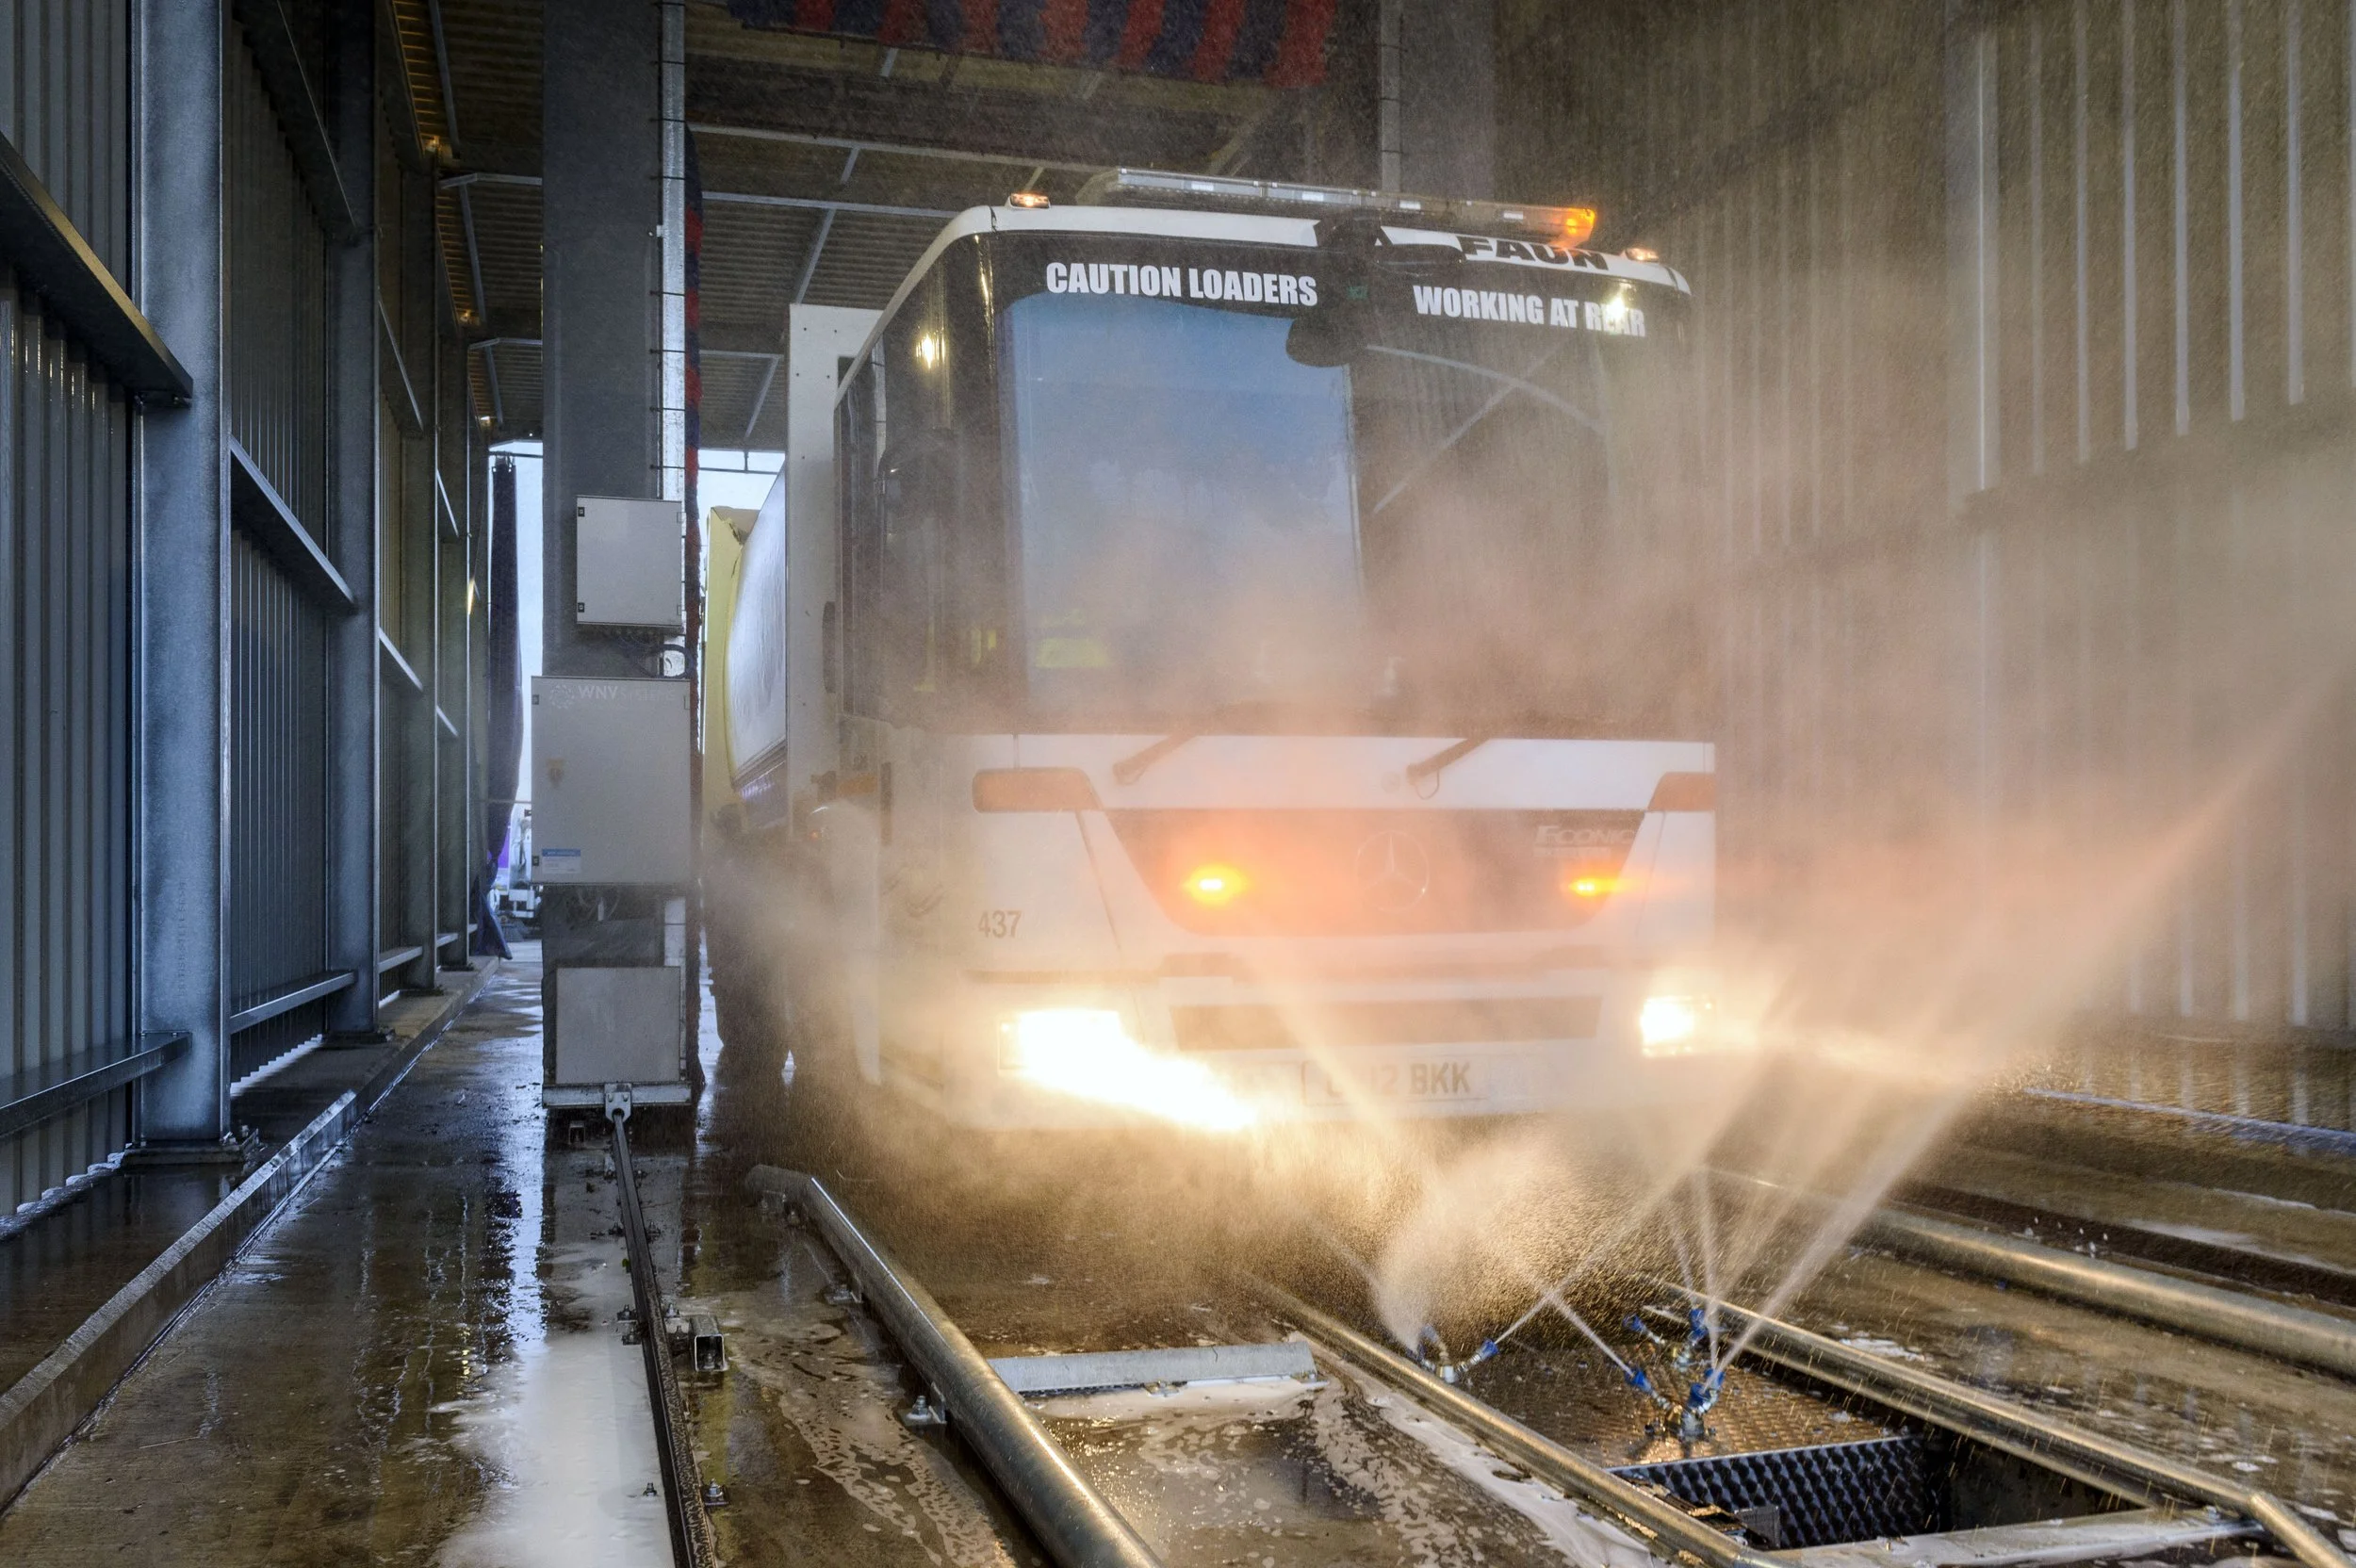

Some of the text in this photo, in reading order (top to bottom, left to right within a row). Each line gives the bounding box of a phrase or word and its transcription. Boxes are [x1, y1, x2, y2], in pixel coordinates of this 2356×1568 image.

[1457, 236, 1609, 270] FAUN
[1046, 262, 1317, 306] CAUTION LOADERS
[1413, 286, 1544, 325] WORKING
[1550, 297, 1579, 329] AT
[978, 909, 1022, 939] 437
[1410, 1062, 1471, 1095] BKK
